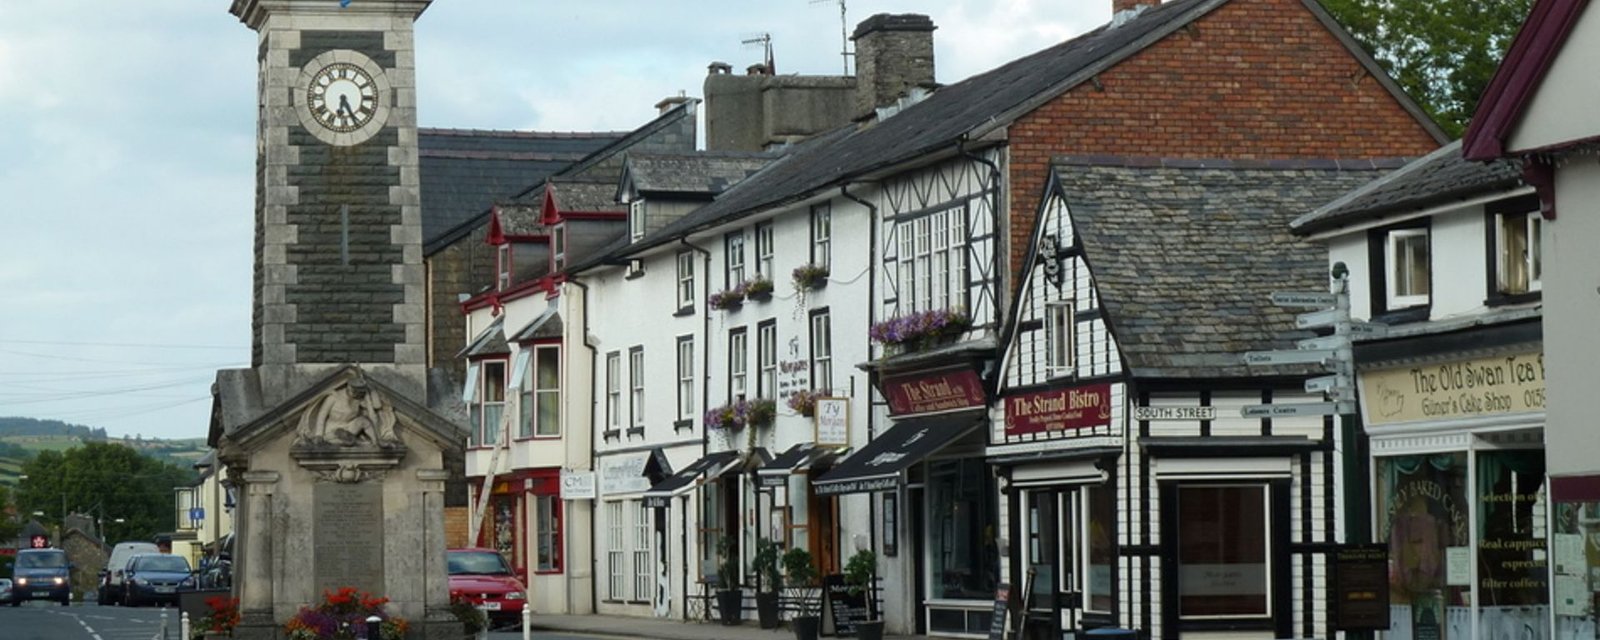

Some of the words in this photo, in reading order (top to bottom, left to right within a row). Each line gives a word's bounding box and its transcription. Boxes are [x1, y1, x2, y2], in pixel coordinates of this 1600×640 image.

[1410, 367, 1437, 394] The
[1438, 364, 1463, 391] Old
[1464, 361, 1505, 389] Swan
[1506, 355, 1536, 386] Tea
[901, 382, 922, 402] The
[919, 376, 953, 400] Strand
[1014, 397, 1033, 416] The
[1033, 391, 1066, 414] Strand
[1069, 389, 1100, 410] Bistro
[1137, 406, 1172, 418] SOUTH
[1176, 406, 1213, 418] STREET
[1459, 392, 1483, 414] Cake
[1484, 390, 1512, 413] Shop
[1409, 479, 1441, 500] BAKED
[1478, 538, 1502, 550] Real
[1509, 578, 1538, 589] coffee
